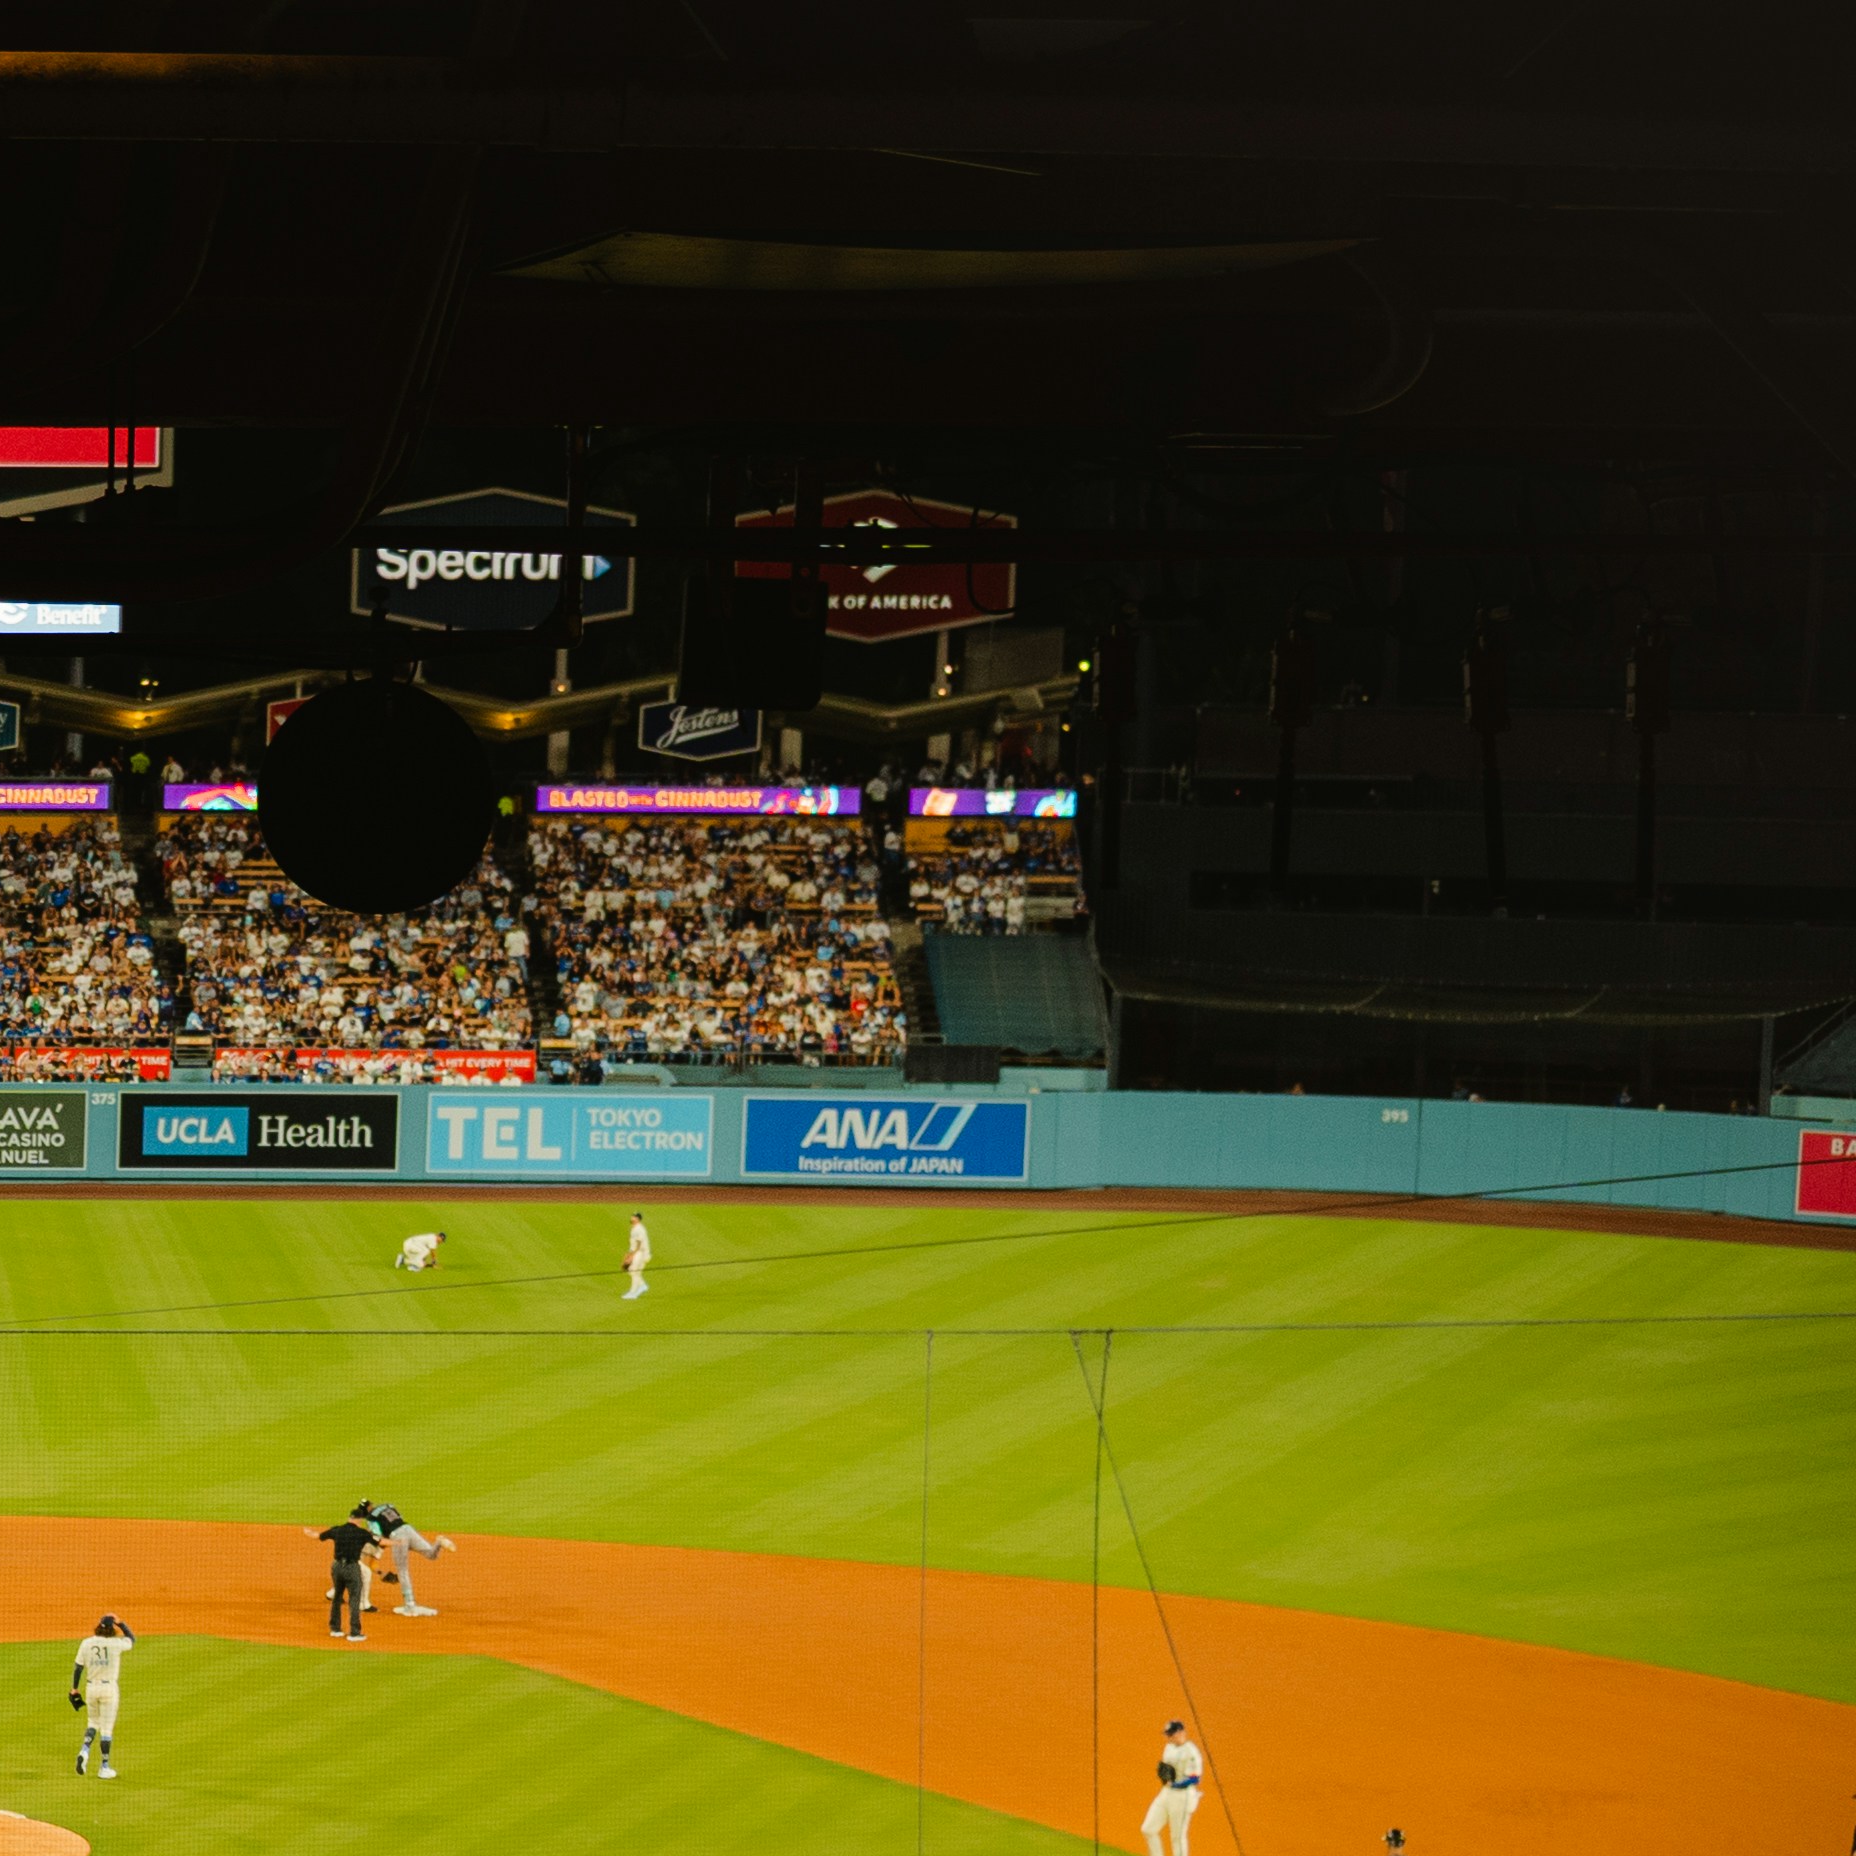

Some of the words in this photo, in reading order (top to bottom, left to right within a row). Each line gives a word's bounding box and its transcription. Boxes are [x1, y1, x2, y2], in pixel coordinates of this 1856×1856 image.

[843, 595, 867, 609] OF
[870, 595, 952, 609] AMERICA
[37, 605, 108, 625] Benefit
[656, 706, 739, 749] Jostens
[549, 791, 629, 807] BLASTED
[654, 791, 762, 807] CINNADUST
[141, 1056, 168, 1065] TIME
[91, 1093, 116, 1105] 375
[588, 1107, 662, 1127] TOKYO
[157, 1118, 236, 1144] UCLA
[257, 1115, 373, 1148] Health
[437, 1107, 562, 1160] TEL
[801, 1108, 909, 1150] ANA
[589, 1129, 704, 1151] ELECTRON
[798, 1155, 885, 1174] Inspiration
[888, 1156, 908, 1172] of
[908, 1157, 964, 1174] JAPAN
[91, 1646, 108, 1659] 31
